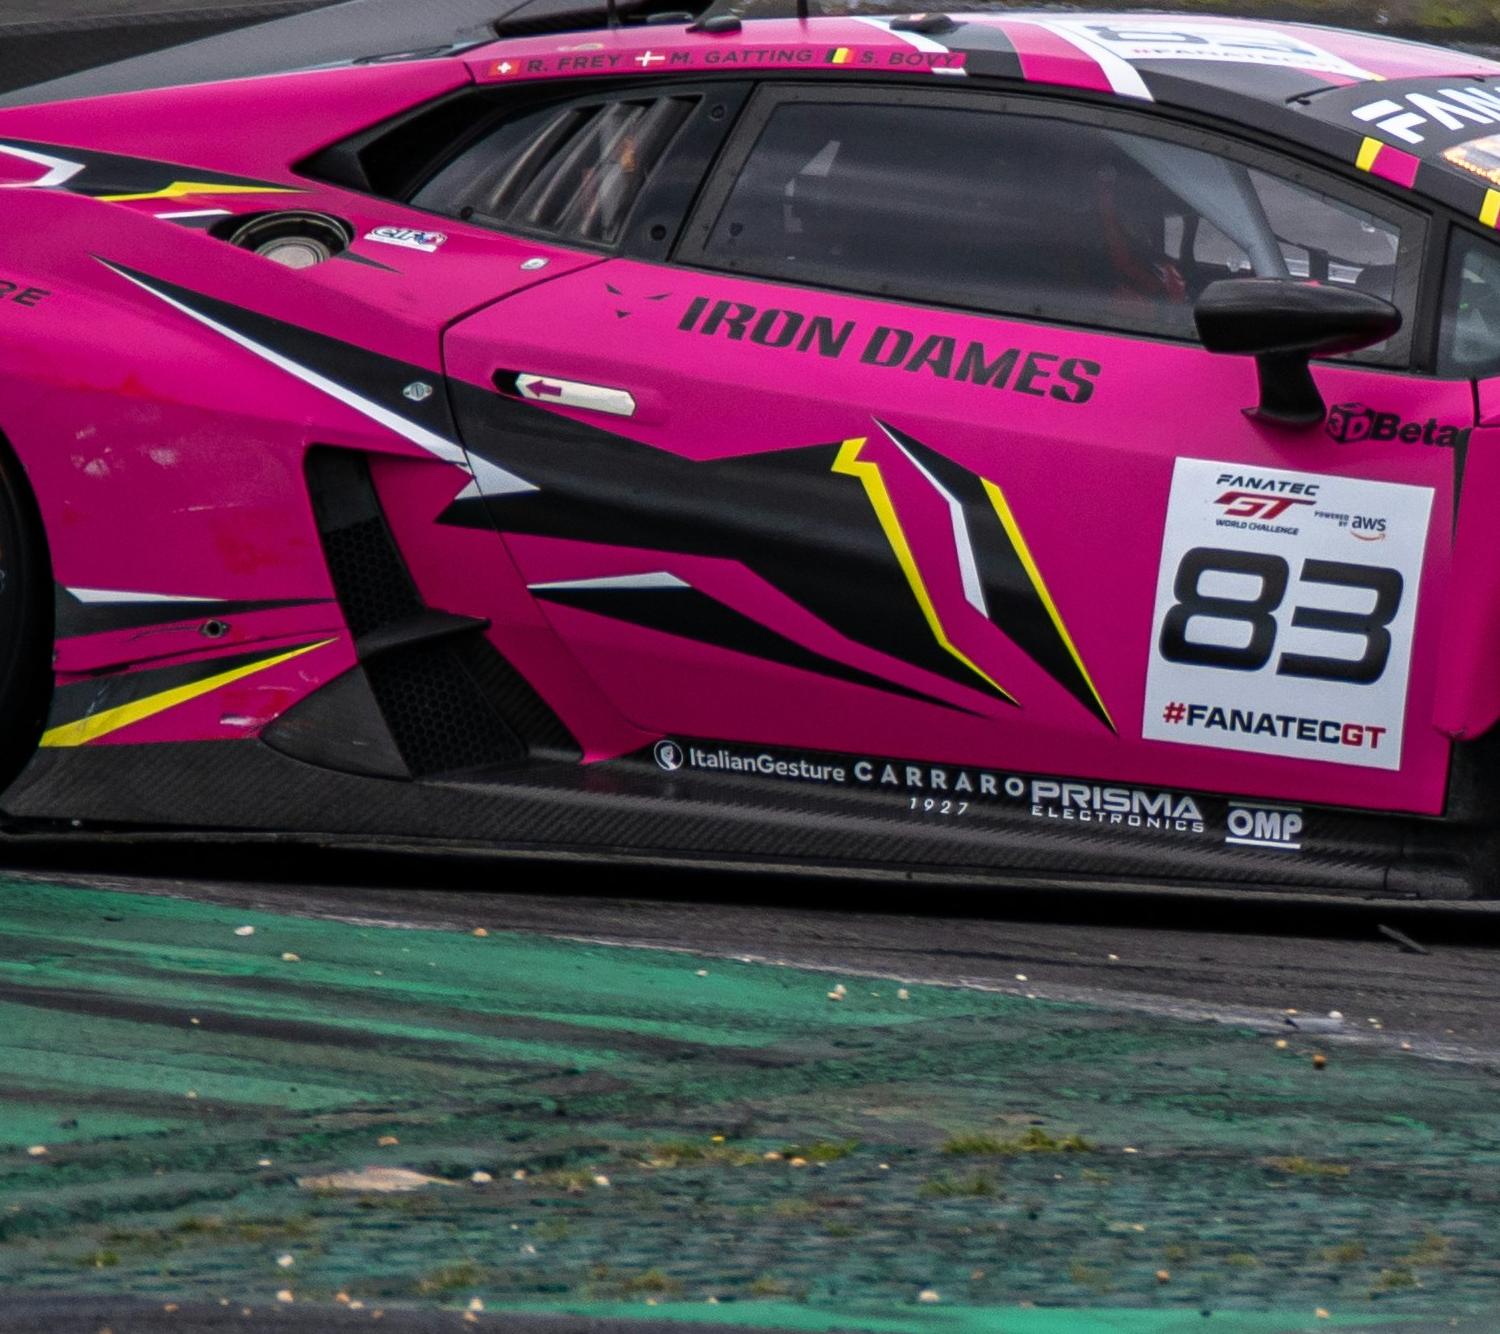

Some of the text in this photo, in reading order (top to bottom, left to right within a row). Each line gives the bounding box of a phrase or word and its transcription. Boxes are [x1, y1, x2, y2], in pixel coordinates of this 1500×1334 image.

[557, 54, 622, 71] FREY
[704, 50, 812, 64] GATTING
[888, 52, 958, 67] BOVY
[677, 297, 1101, 404] IRON DAMES
[1216, 474, 1320, 496] FANATEC
[1215, 519, 1299, 535] WORLD CHALLENGE
[1352, 515, 1386, 532] aws
[1158, 547, 1404, 685] 83
[1162, 701, 1387, 749] #FANATECGT
[689, 747, 846, 783] ItalianGesture
[854, 761, 1025, 797] CARRARO
[910, 797, 969, 815] 1927
[1030, 780, 1203, 820] PRISMA
[1031, 805, 1205, 833] ELECTRONICS
[1227, 808, 1303, 842] OMP
